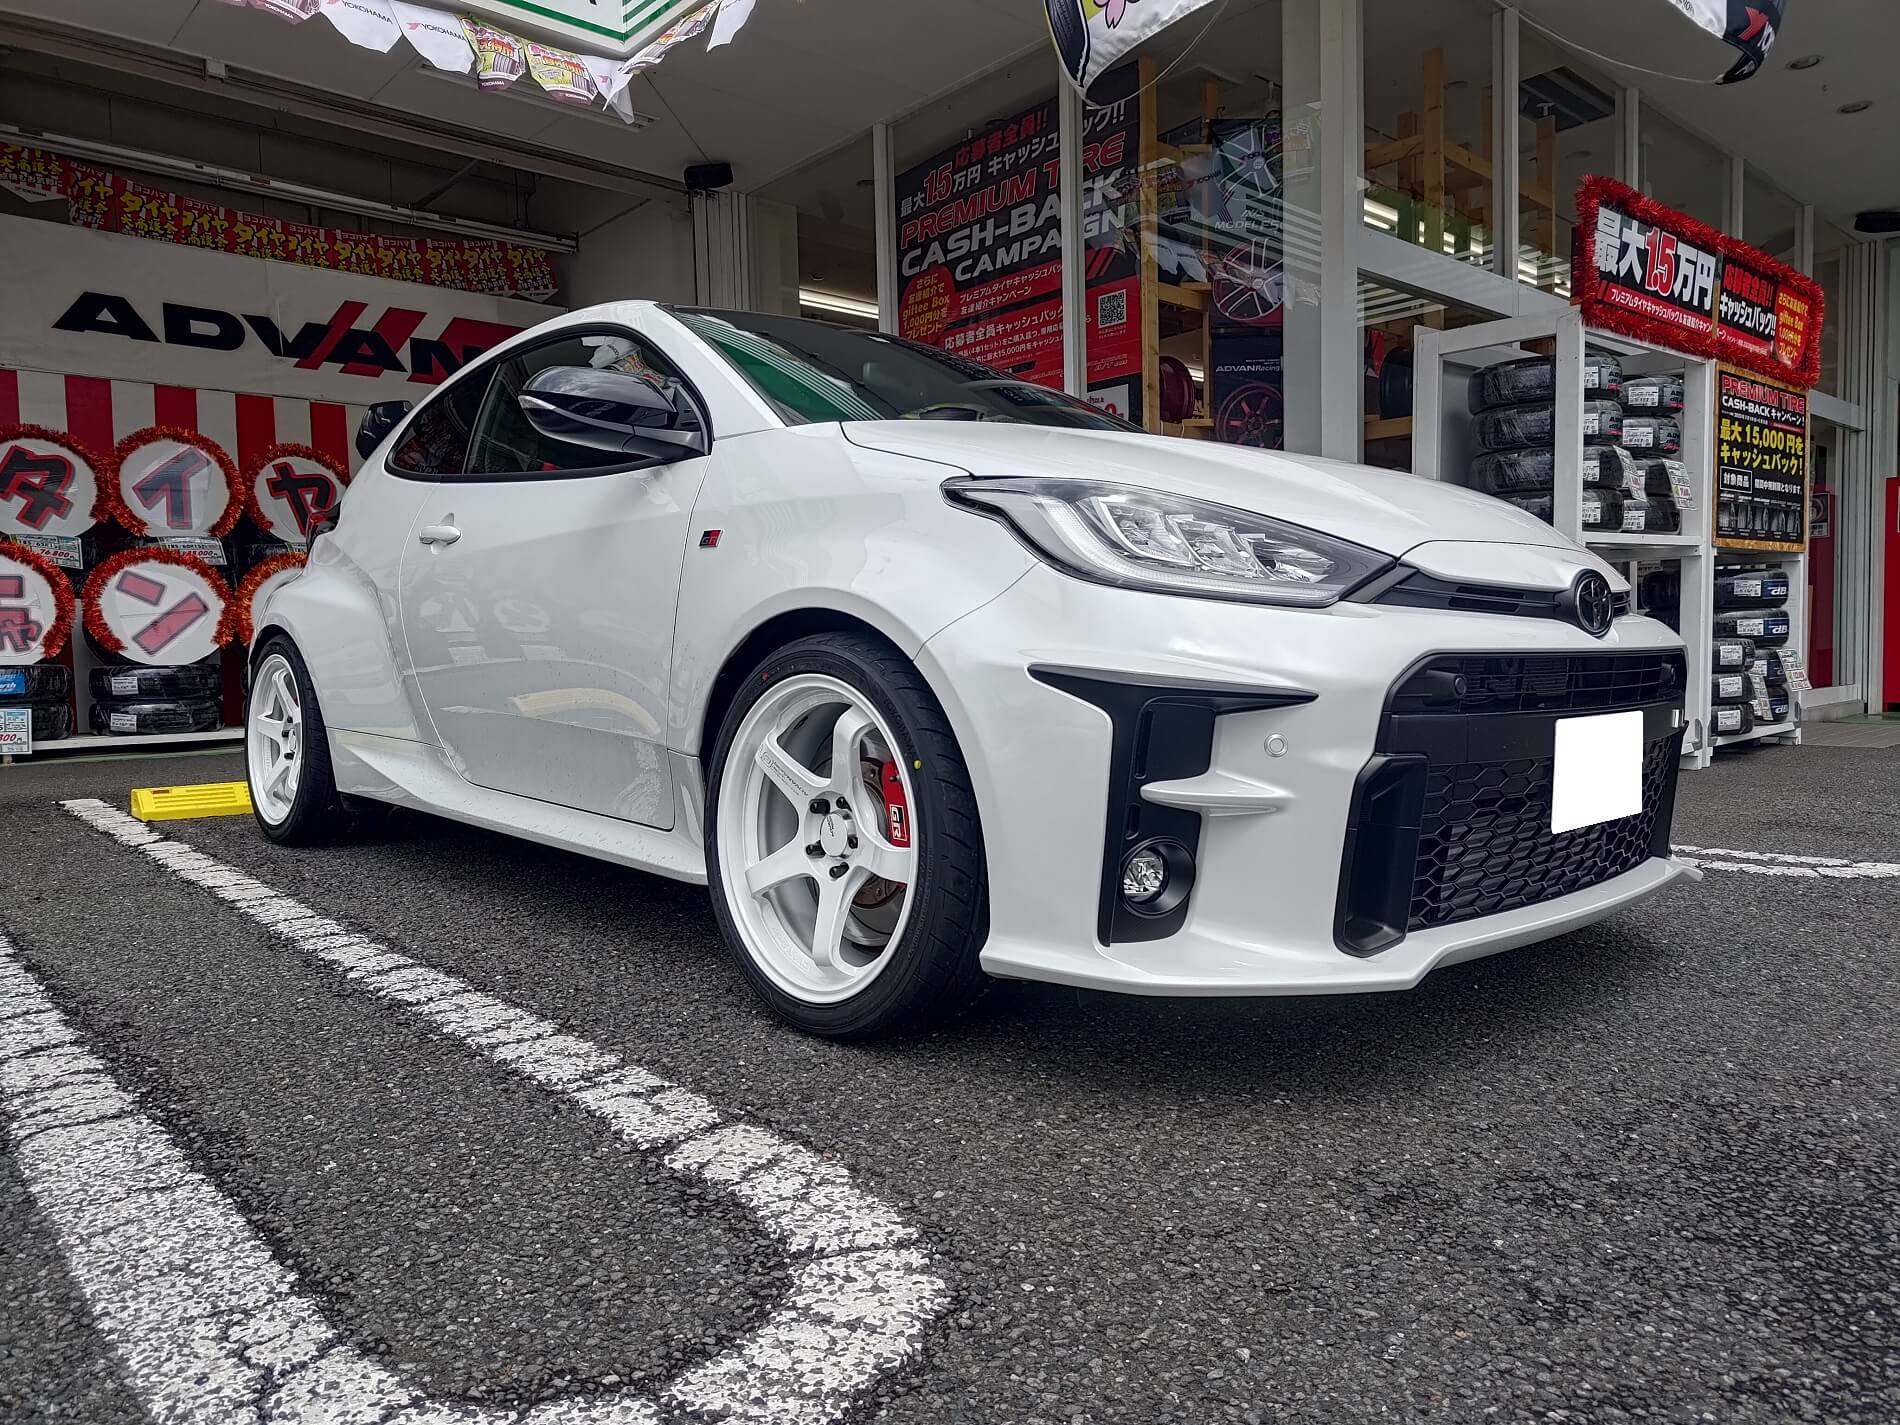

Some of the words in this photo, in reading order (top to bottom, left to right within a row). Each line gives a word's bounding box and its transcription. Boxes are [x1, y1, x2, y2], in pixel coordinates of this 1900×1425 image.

[341, 1, 392, 25] YOKOHAMA
[901, 168, 1037, 250] PREMIUM
[1042, 131, 1127, 191] TRE
[119, 191, 180, 219] タイヤ
[184, 199, 218, 212] ヨコハマ
[243, 214, 275, 226] ヨコハマ
[901, 168, 1125, 278] CASH-BAK
[232, 222, 286, 246] タイヤ
[954, 203, 1127, 282] CAMPAGN
[377, 248, 422, 268] タイヤ
[931, 293, 951, 309] Box
[52, 291, 480, 385] ADVAN
[1215, 365, 1255, 373] ADVAN
[1721, 374, 1778, 407] PREMIUM
[1779, 390, 1806, 415] TIRE
[1721, 395, 1770, 418] CASH-BACK
[1770, 625, 1788, 635] dB
[891, 806, 902, 838] GR
